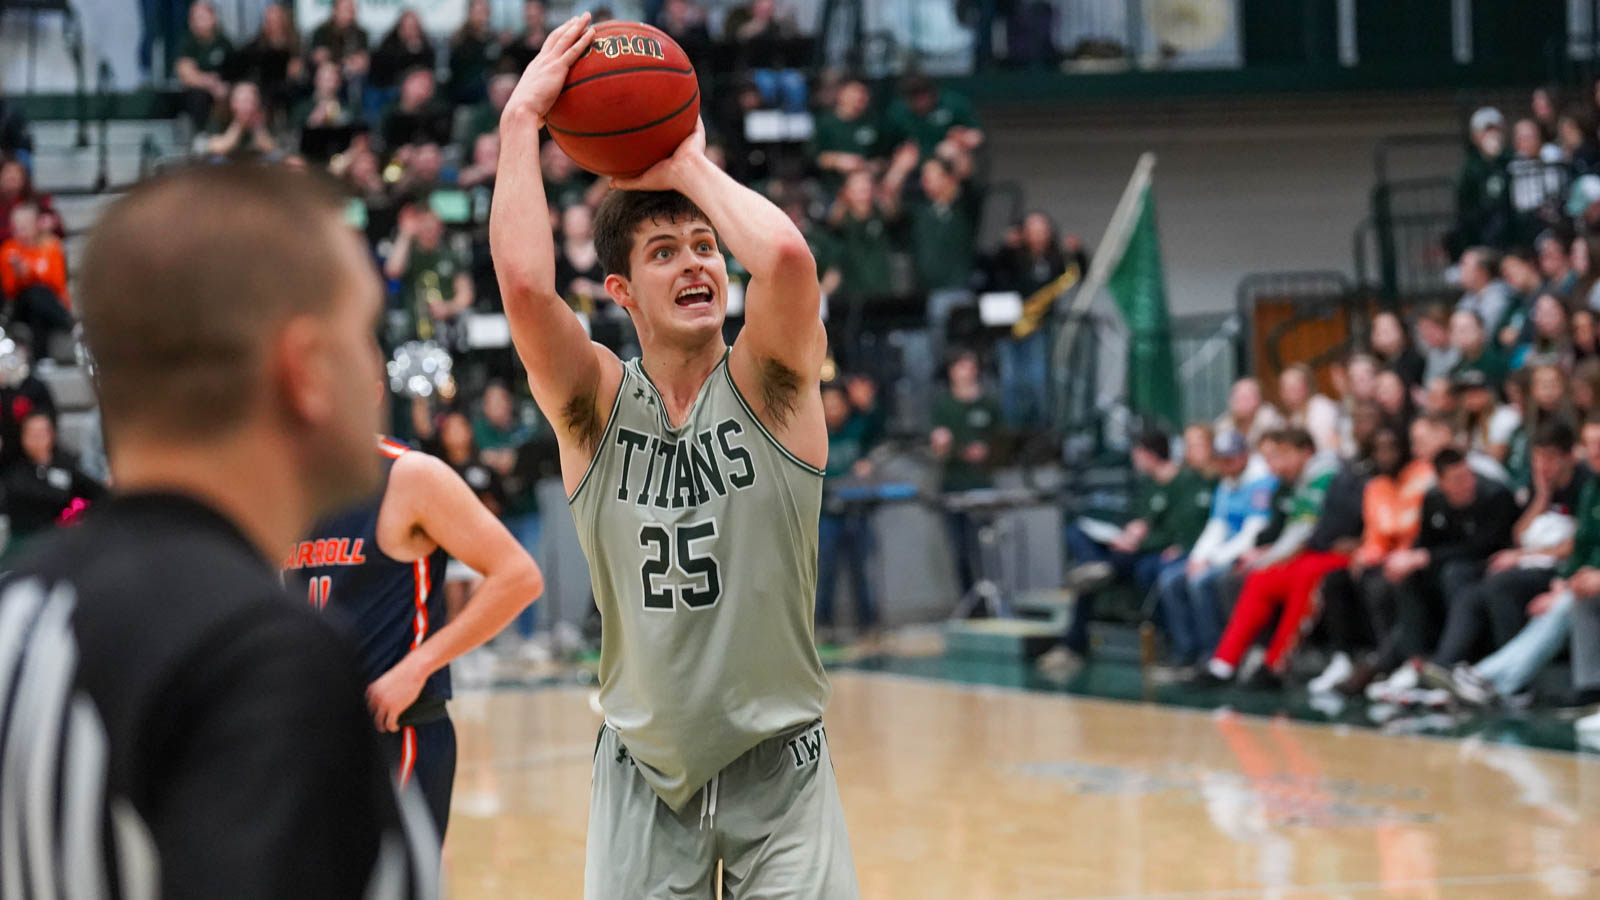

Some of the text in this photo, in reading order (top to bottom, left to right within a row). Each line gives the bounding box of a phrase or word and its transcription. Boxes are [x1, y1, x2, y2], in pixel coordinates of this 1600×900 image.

[580, 35, 664, 60] Wils
[616, 417, 756, 510] TITANS
[283, 537, 366, 570] ARROLL
[638, 517, 722, 612] 25
[787, 727, 828, 770] IW
